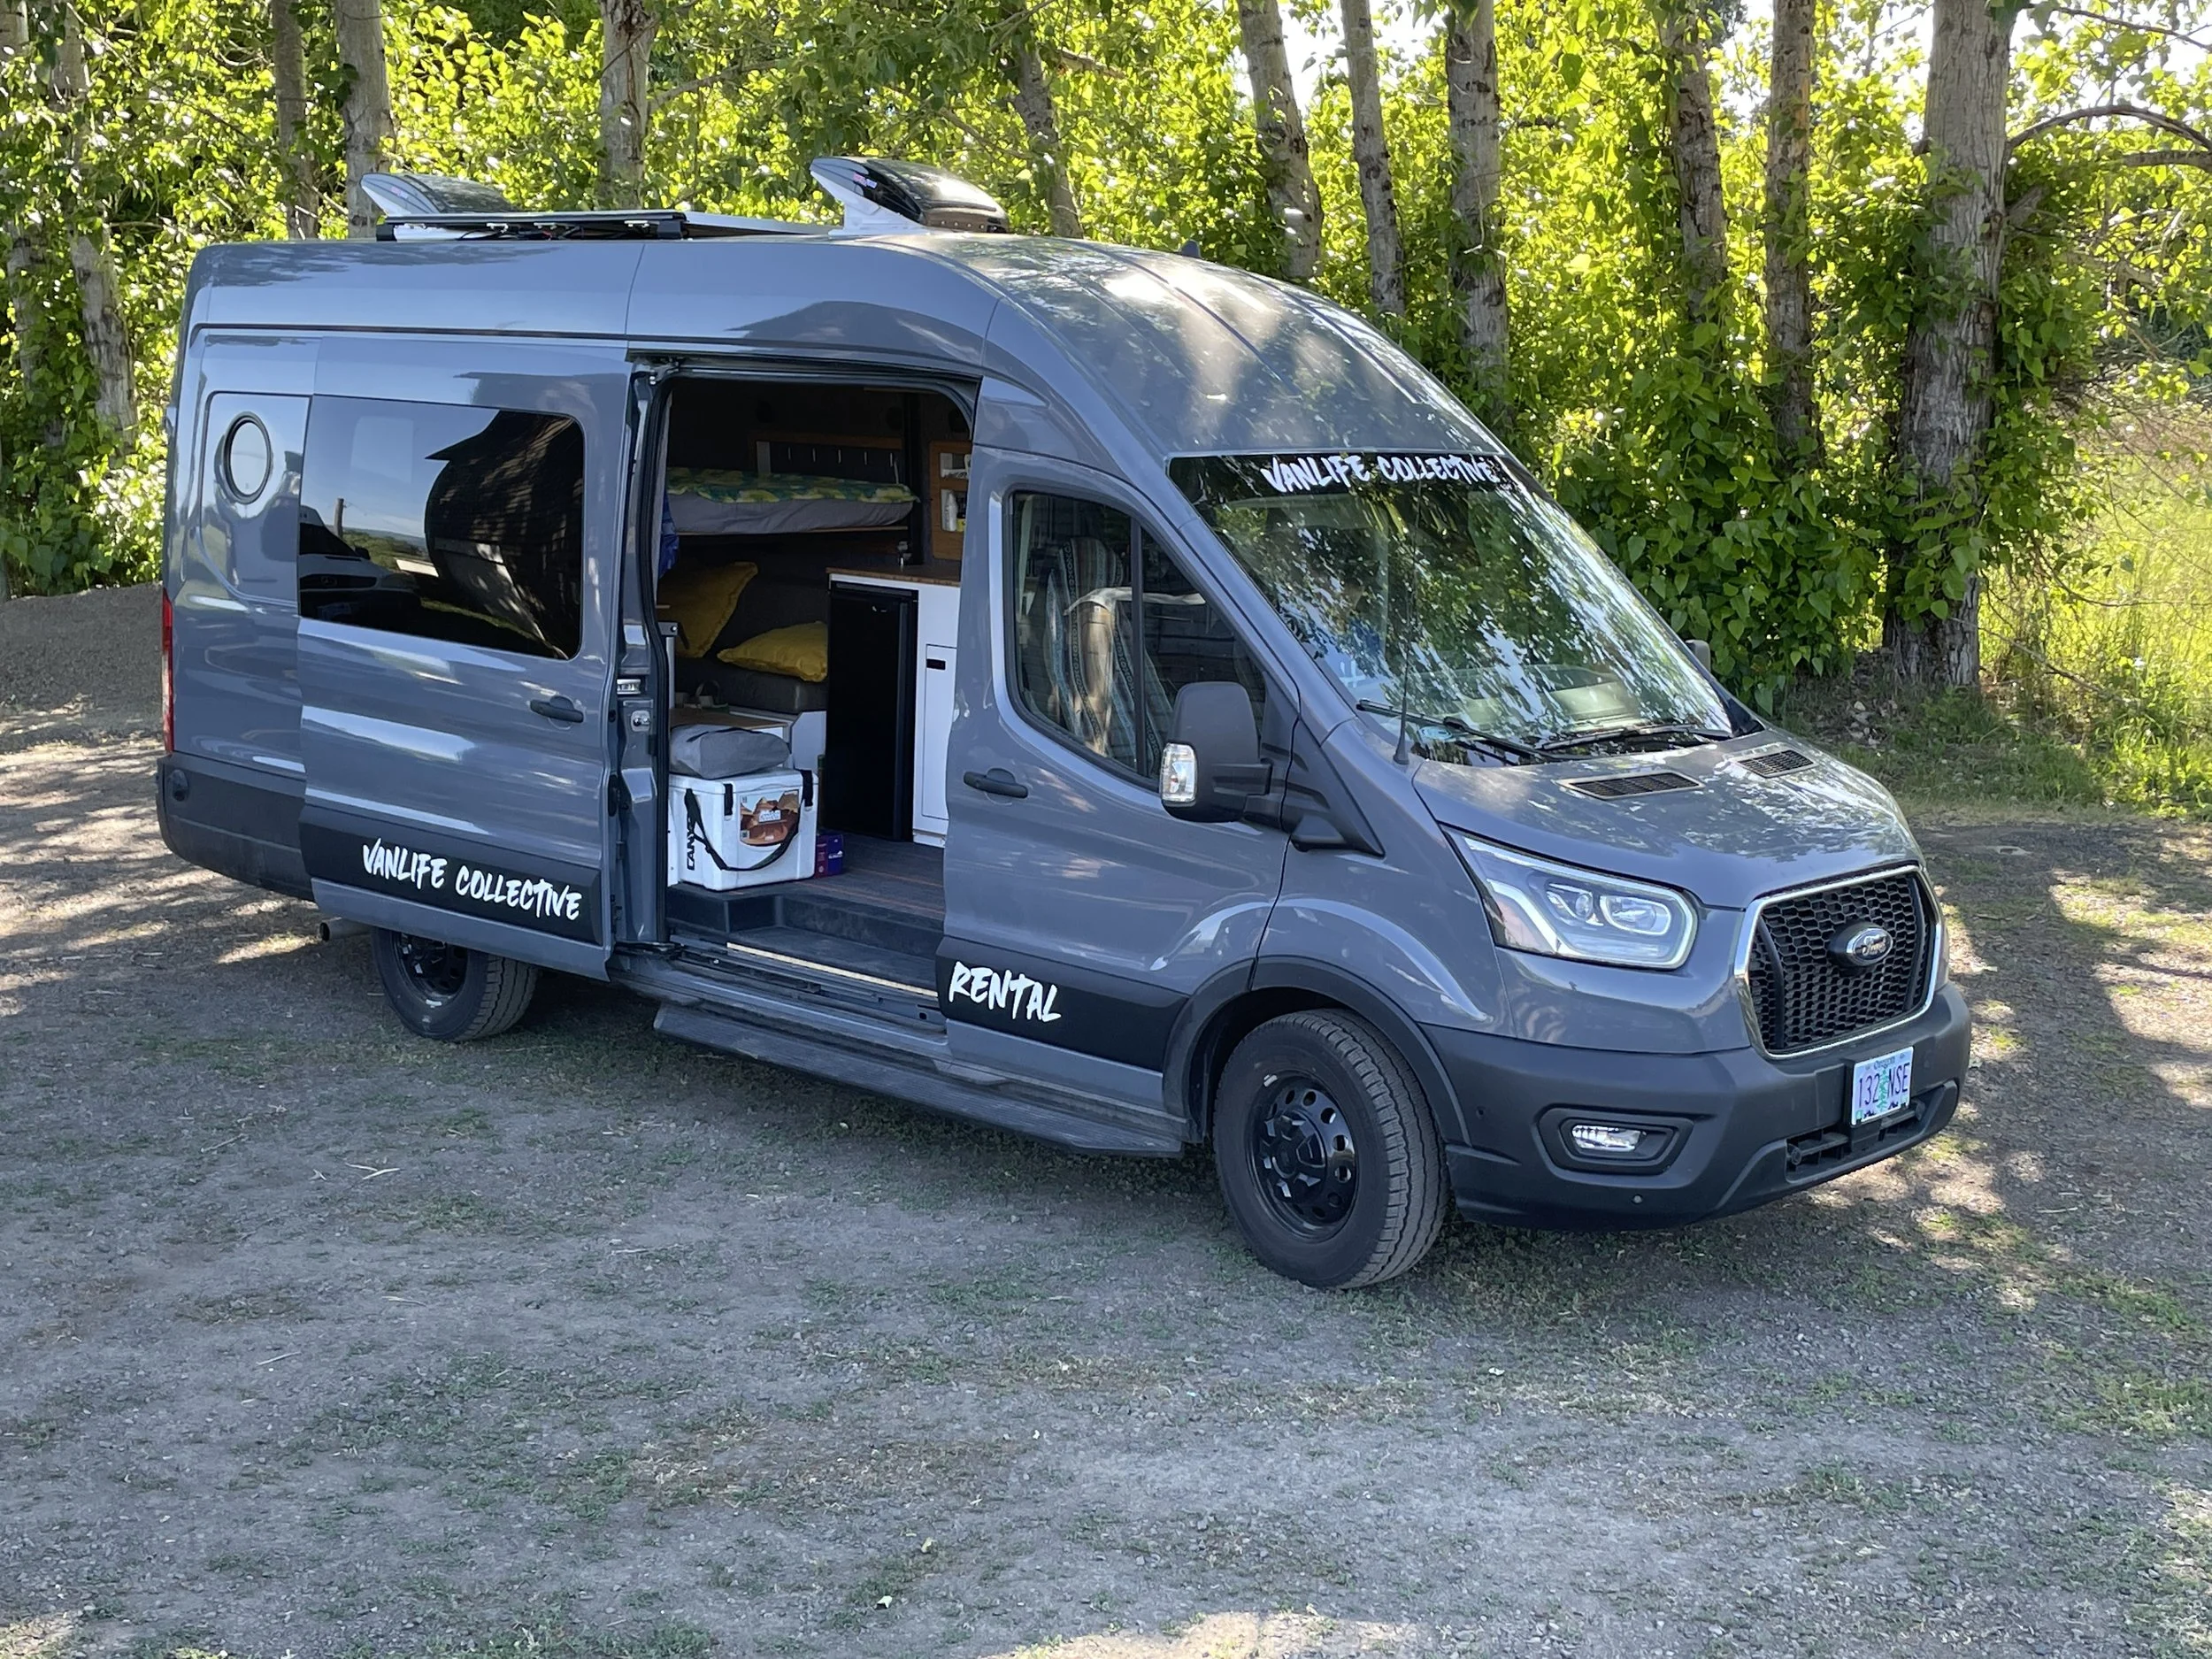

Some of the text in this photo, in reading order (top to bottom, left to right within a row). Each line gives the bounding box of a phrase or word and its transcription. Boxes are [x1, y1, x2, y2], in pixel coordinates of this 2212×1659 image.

[1260, 454, 1501, 493] VANLIFE COLLECTIVE
[363, 837, 582, 920] VANLIFE COLLECTIVE
[949, 961, 1062, 1022] RENTAL
[1858, 1062, 1911, 1109] 132 NSE
